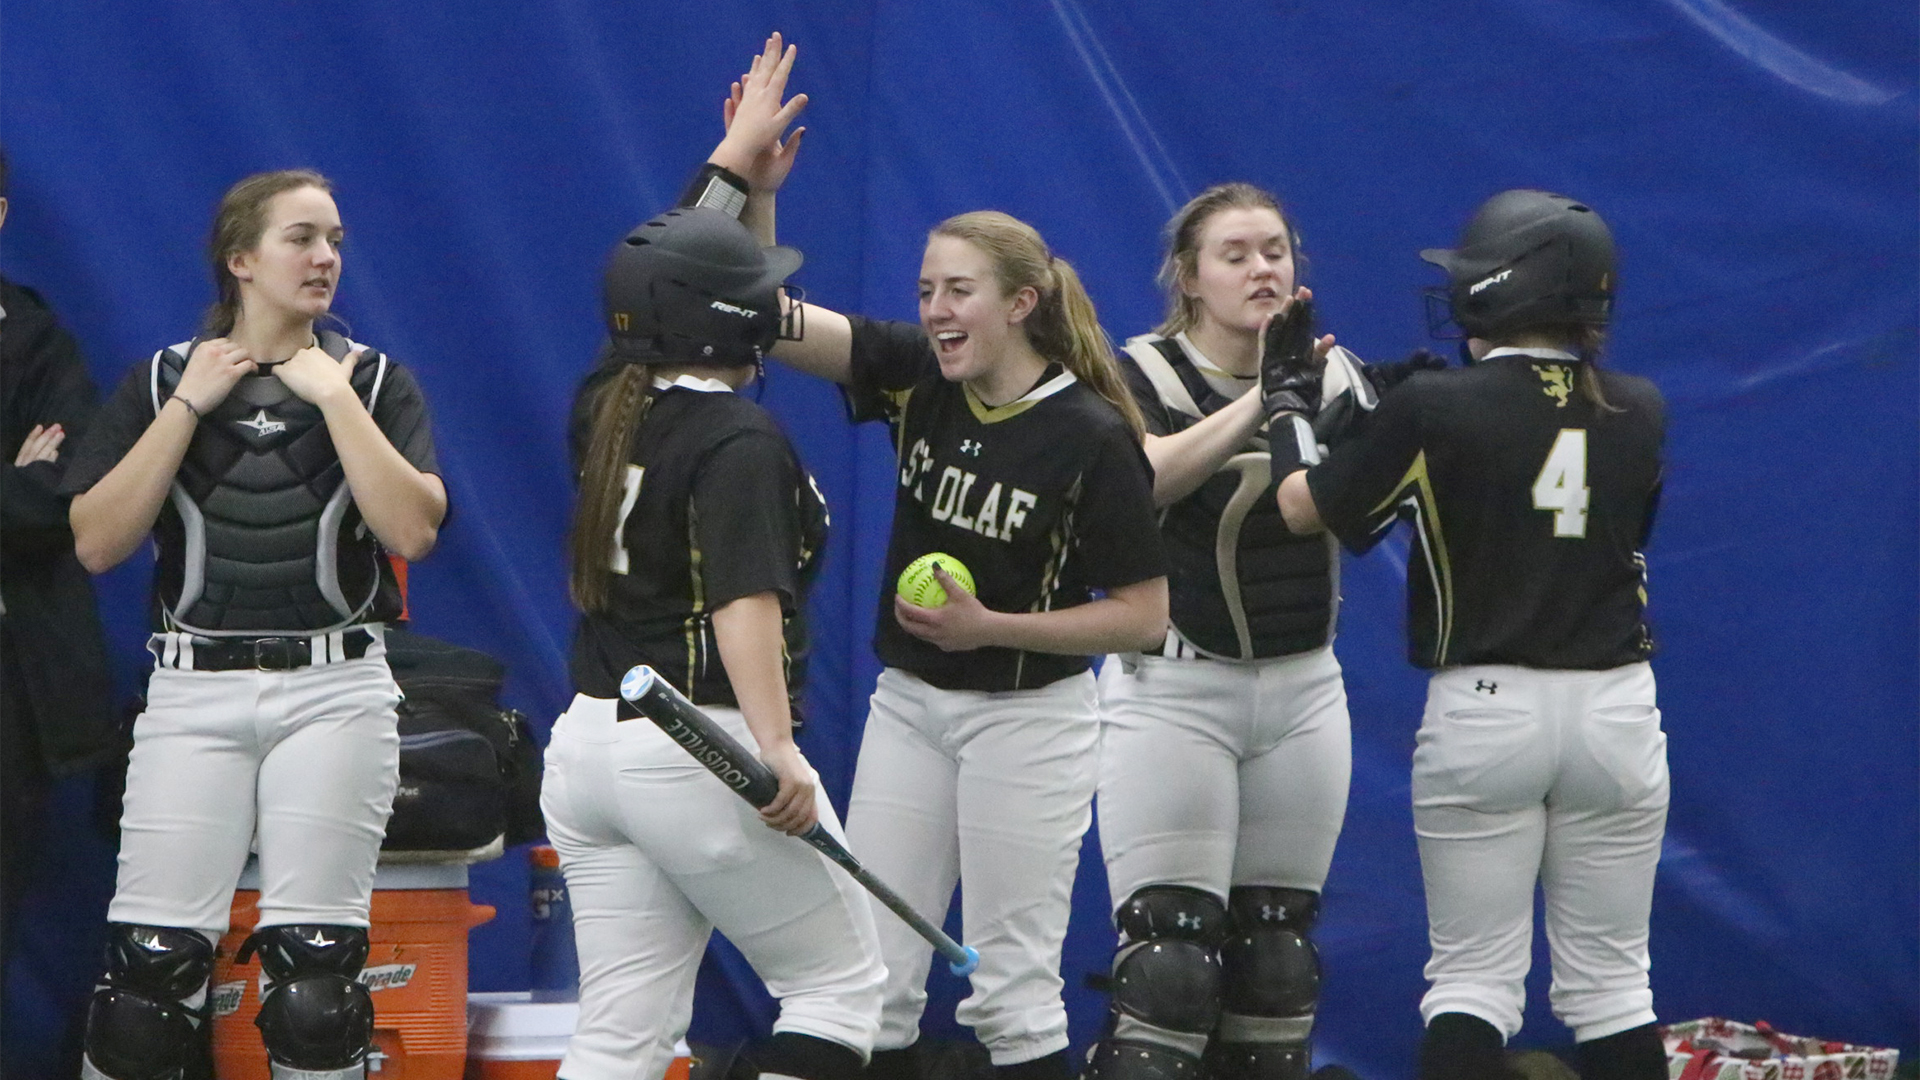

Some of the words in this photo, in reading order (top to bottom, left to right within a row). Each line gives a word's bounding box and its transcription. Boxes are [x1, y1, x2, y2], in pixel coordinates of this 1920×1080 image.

[1470, 269, 1512, 295] RIP-IT
[614, 313, 629, 331] 17
[710, 301, 758, 318] RIP-IT
[1532, 428, 1590, 538] 4
[932, 465, 1038, 543] OLAF
[664, 718, 751, 790] LOUISVILLE
[361, 966, 412, 988] torade
